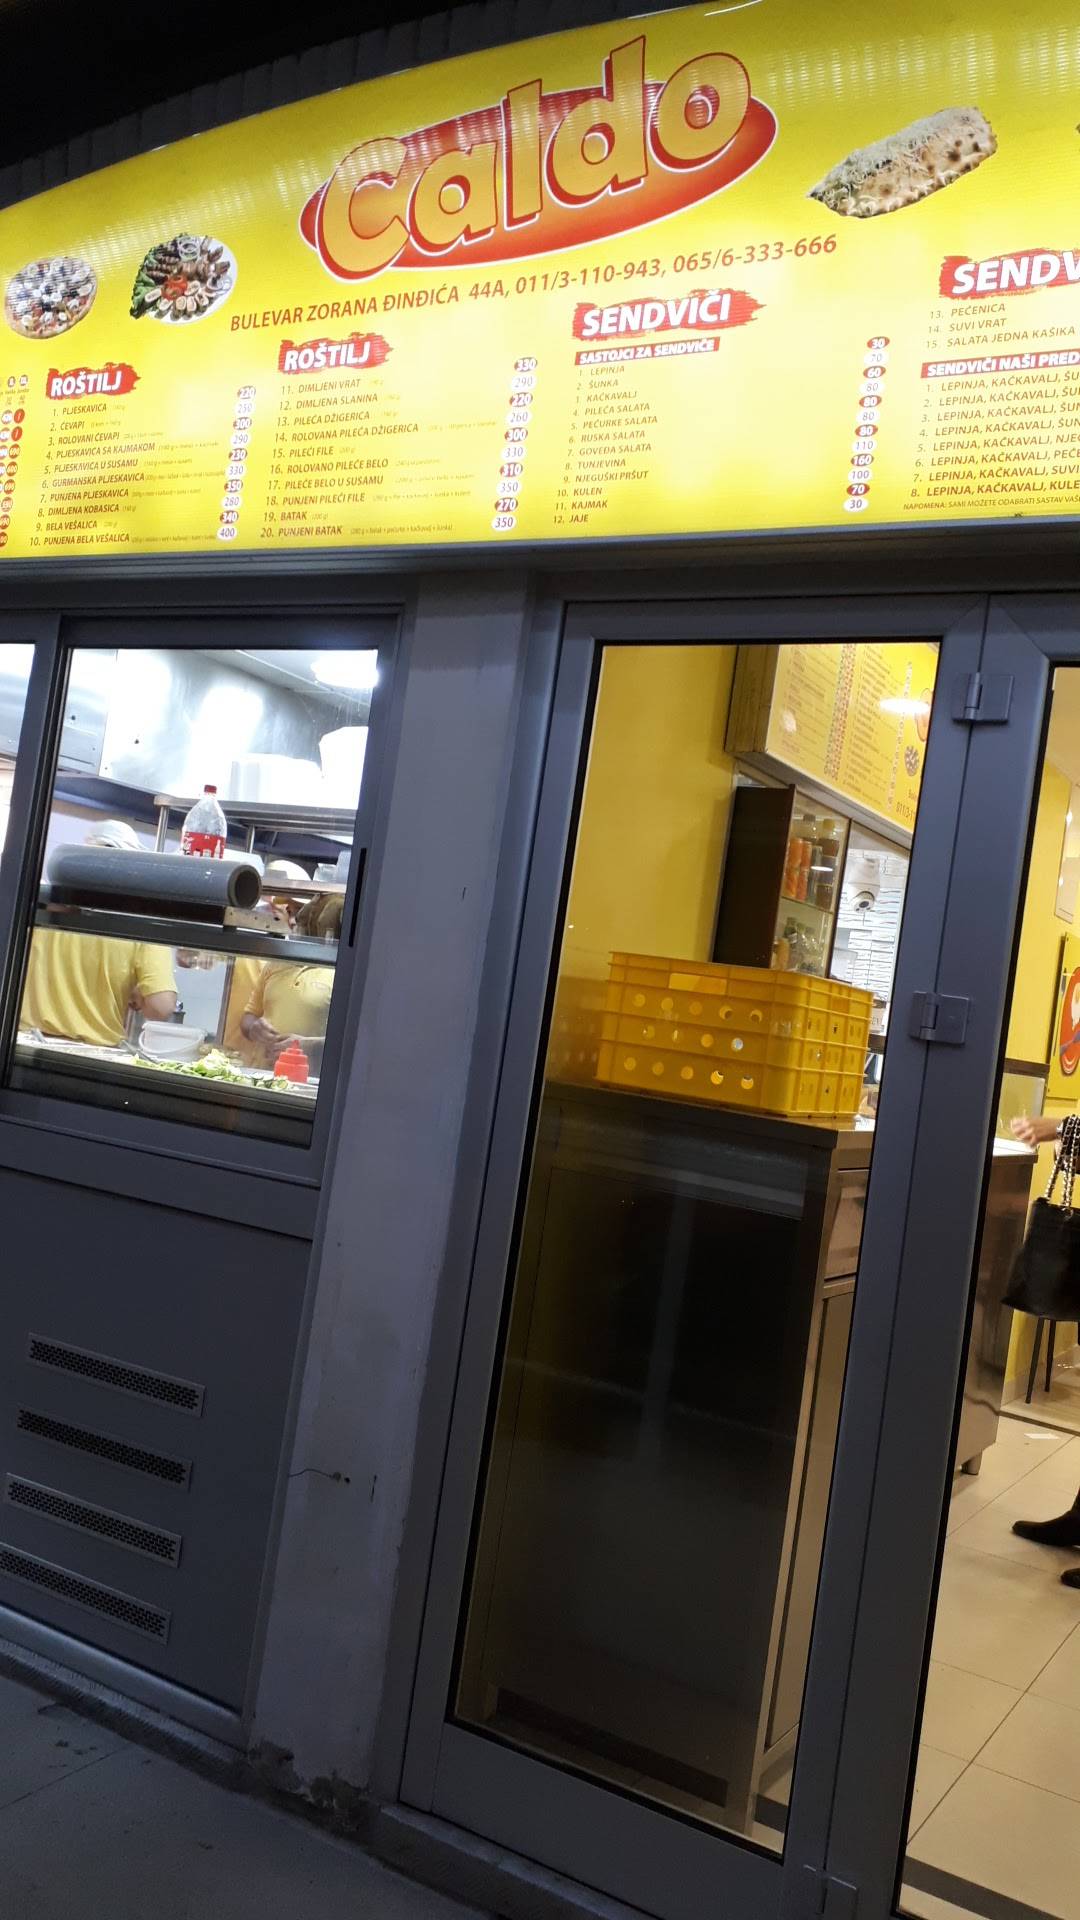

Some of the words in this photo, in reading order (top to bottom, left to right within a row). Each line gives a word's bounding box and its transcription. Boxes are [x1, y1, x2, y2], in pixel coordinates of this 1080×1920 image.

[318, 35, 751, 281] Caldo
[230, 307, 303, 332] BULEVAR
[306, 296, 378, 322] ZORANA
[382, 283, 460, 312] ĐINĐIĆA
[468, 279, 510, 299] 44A,
[515, 258, 666, 294] 011/3-110-943,
[673, 233, 837, 274] 065/6-333-666
[581, 289, 731, 337] SENDVIČI
[951, 303, 1006, 317] PEČENICA
[949, 321, 975, 332] SUVI
[978, 317, 1007, 329] VRAT
[871, 337, 886, 349] 30
[947, 334, 988, 348] SALATA
[991, 330, 1029, 343] JEDNA
[284, 341, 370, 371] ROŠTILJ
[579, 347, 634, 365] SASTOJCI
[636, 346, 651, 359] ZA
[654, 338, 715, 356] SENDVIČE
[516, 358, 535, 371] 330
[590, 365, 625, 376] LEPINJA
[927, 355, 997, 377] SENDVIČI
[999, 353, 1037, 370] NAŠI
[867, 367, 882, 378] 60
[50, 370, 122, 397] ROŠTILJ
[298, 381, 337, 394] DIMLJENI
[339, 379, 360, 389] VRAT
[515, 376, 533, 388] 290
[941, 379, 989, 392] LEPINJA,
[296, 397, 338, 409] DIMLJENA
[340, 393, 378, 404] SLANINA
[511, 393, 531, 406] 220
[939, 394, 987, 406] LEPINJA,
[62, 403, 107, 415] PLJESKAVICA
[617, 402, 651, 413] SALATA
[324, 411, 370, 423] DŽIGERICA
[510, 411, 528, 423] 260
[624, 415, 658, 426] SALATA
[862, 411, 875, 421] 80
[937, 409, 985, 422] LEPINJA,
[235, 418, 251, 429] 300
[935, 425, 983, 437] LEPINJA,
[985, 419, 1055, 433] KAČKAVALJ,
[291, 429, 337, 442] ROLOVANA
[340, 426, 369, 438] PILEĆA
[371, 423, 419, 436] DŽIGERICA
[507, 428, 526, 441] 300
[613, 430, 645, 440] SALATA
[858, 425, 874, 437] 80
[58, 433, 93, 445] ROLOVANI
[233, 434, 249, 445] 290
[855, 440, 874, 450] 110
[933, 440, 981, 452] LEPINJA,
[983, 435, 1053, 449] KAČKAVALJ,
[56, 447, 101, 459] PLJESKAVICA
[102, 446, 111, 455] SA
[112, 443, 155, 453] KAJMAKOM
[316, 446, 334, 456] FILE
[505, 446, 524, 458] 330
[618, 443, 652, 454] SALATA
[231, 449, 246, 461] 230
[853, 454, 872, 466] 160
[931, 454, 979, 467] LEPINJA,
[981, 450, 1051, 464] KAČKAVALJ,
[54, 462, 99, 474] PLJESKAVICA
[100, 461, 106, 469] U
[106, 459, 138, 469] SUSAMU
[229, 466, 244, 475] 330
[287, 462, 334, 474] ROLOVANO
[366, 458, 389, 469] BELO
[502, 463, 522, 477] 310
[577, 459, 626, 470] TUNJEVINA
[575, 471, 618, 483] NJEGUŠKI
[619, 470, 649, 480] PRŠUT
[851, 469, 870, 480] 100
[929, 470, 976, 482] LEPINJA,
[979, 466, 1049, 480] KAČKAVALJ,
[1051, 463, 1080, 475] SUVI
[52, 476, 97, 488] GURMANSKA
[98, 473, 145, 484] PLJESKAVICA
[227, 480, 242, 492] 350
[314, 478, 336, 488] BELO
[337, 478, 344, 486] U
[346, 475, 384, 486] SUSAMU
[500, 481, 519, 493] 350
[573, 487, 603, 497] KULEN
[851, 483, 866, 495] 70
[926, 484, 974, 497] LEPINJA,
[977, 481, 1047, 495] KAČKAVALJ,
[50, 491, 81, 502] PUNJENA
[83, 488, 129, 500] PLJESKAVICA
[282, 495, 318, 506] PUNJENI
[347, 492, 366, 503] FILE
[224, 497, 240, 507] 280
[497, 498, 517, 512] 270
[571, 500, 608, 510] KAJMAK
[850, 499, 863, 509] 30
[48, 506, 82, 516] DIMLJENA
[83, 503, 120, 514] KOBASICA
[222, 511, 237, 523] 340
[280, 511, 308, 521] BATAK
[495, 516, 514, 528] 350
[568, 514, 589, 523] JAJE
[46, 522, 63, 531] BELA
[64, 520, 98, 530] VEŠALICA
[278, 527, 314, 537] PUNJENI
[315, 525, 343, 536] BATAK
[220, 528, 235, 537] 400
[43, 535, 75, 546] PUNJENA
[76, 534, 94, 544] BELA
[95, 533, 130, 543] VEŠALICA
